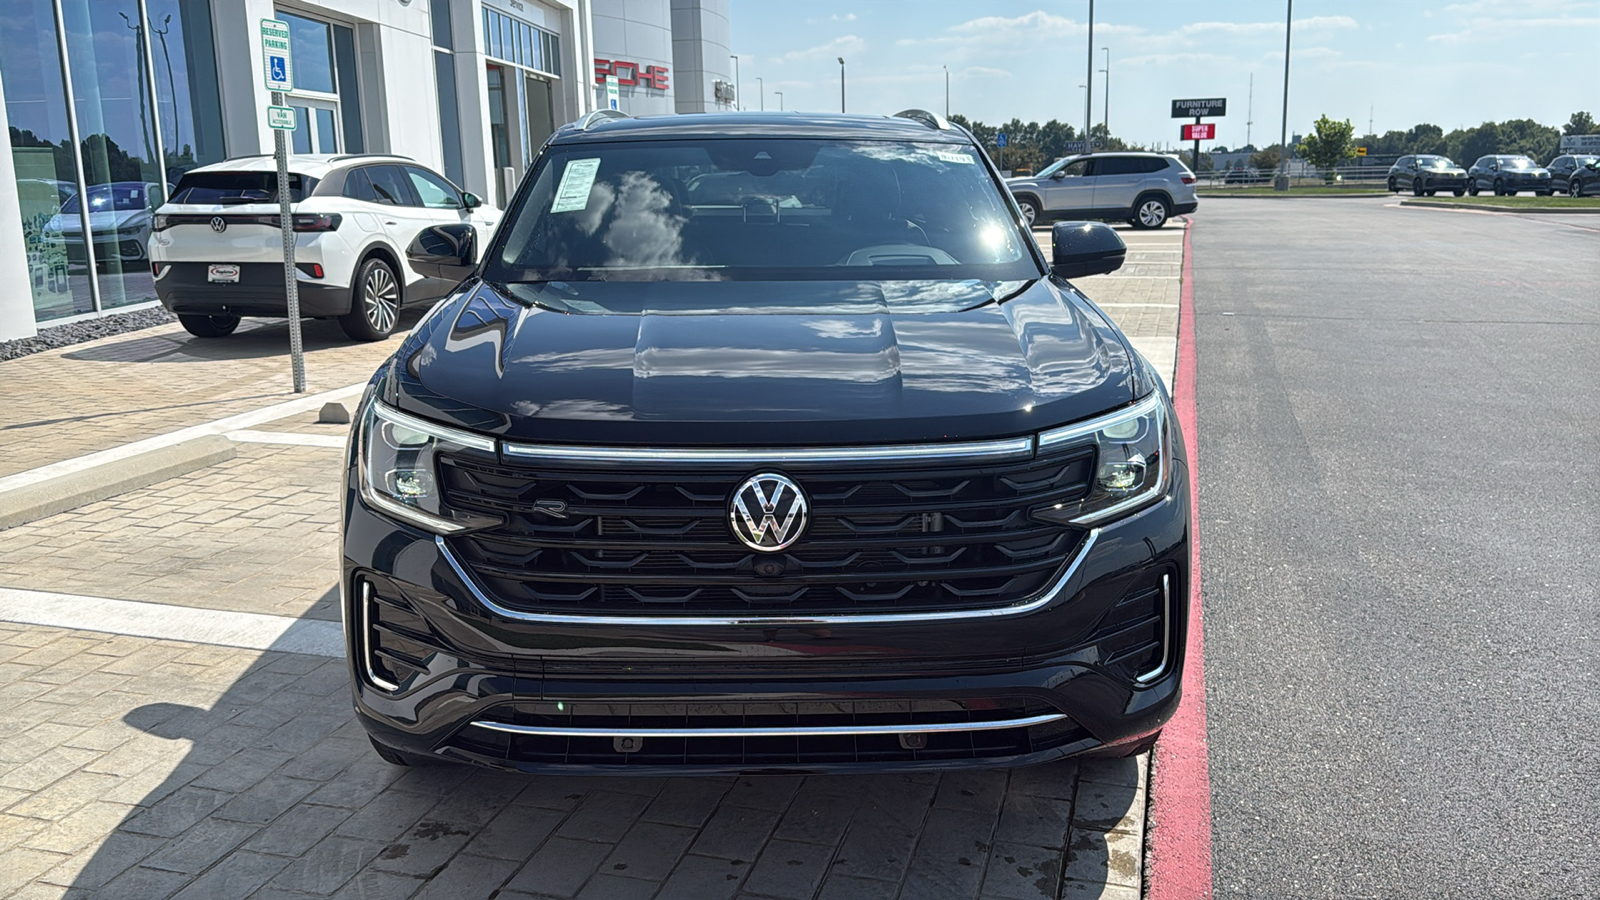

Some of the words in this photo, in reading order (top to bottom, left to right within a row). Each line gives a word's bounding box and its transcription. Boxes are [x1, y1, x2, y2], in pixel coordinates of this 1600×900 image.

[262, 27, 288, 38] RESERVED
[265, 39, 287, 49] PARKING
[1176, 100, 1223, 108] FURNITURE
